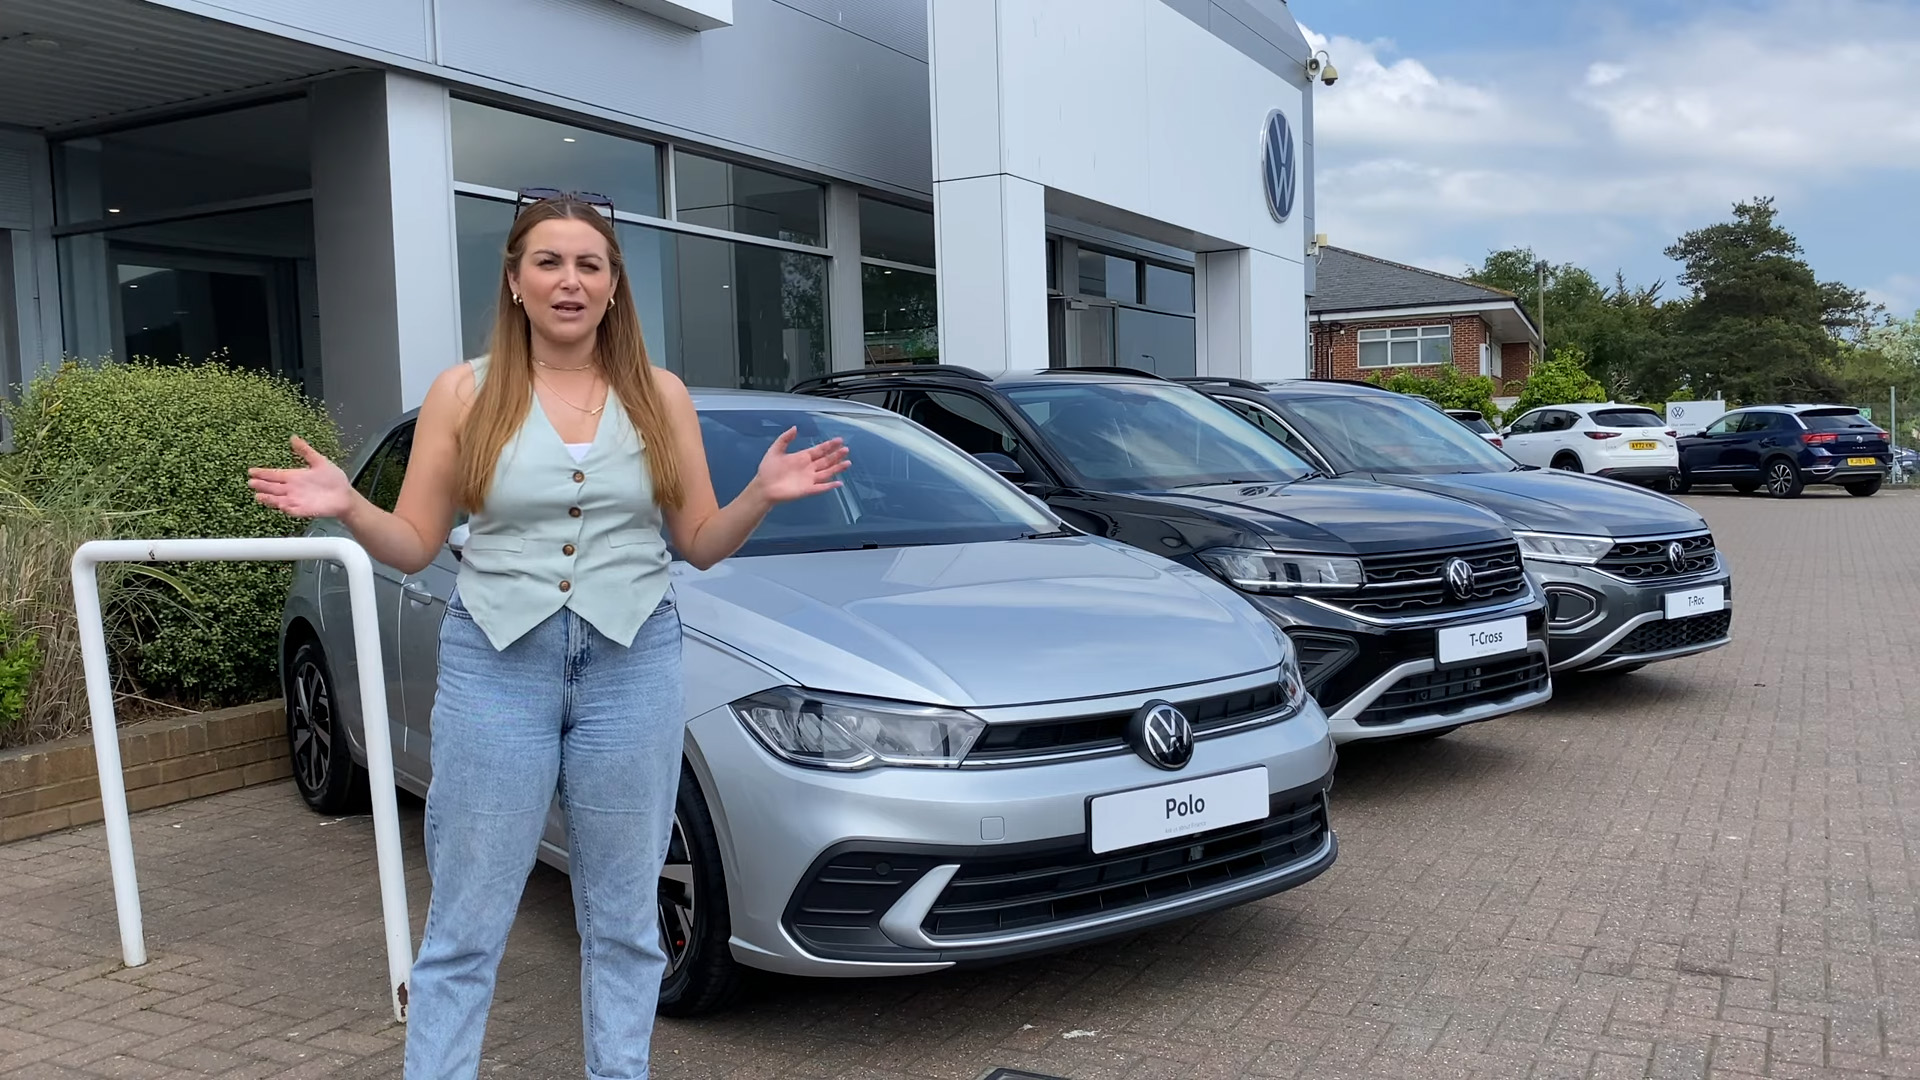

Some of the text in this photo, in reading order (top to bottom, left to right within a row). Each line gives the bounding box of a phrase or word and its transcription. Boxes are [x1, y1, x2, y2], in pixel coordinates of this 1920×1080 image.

[1263, 111, 1296, 219] VW
[1688, 596, 1705, 607] T-Roc
[1469, 631, 1503, 646] T-Cross
[1166, 794, 1205, 820] Polo
